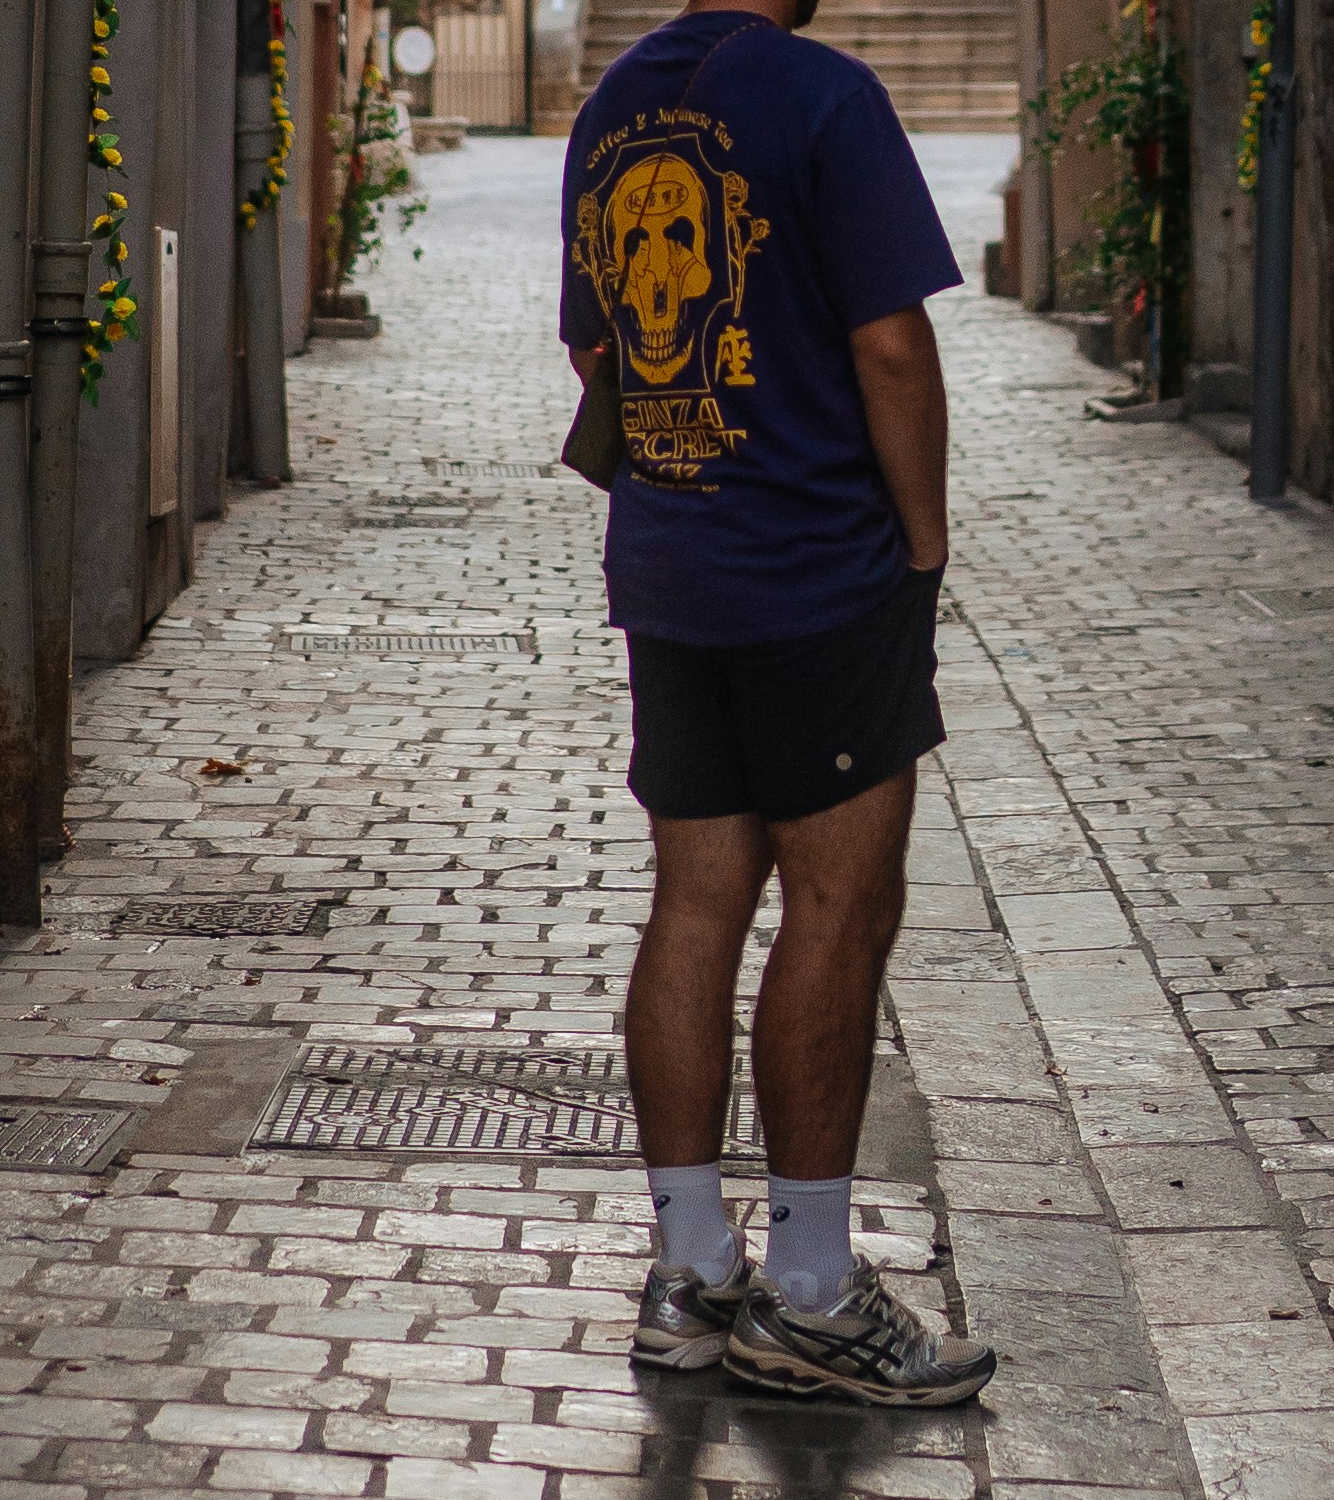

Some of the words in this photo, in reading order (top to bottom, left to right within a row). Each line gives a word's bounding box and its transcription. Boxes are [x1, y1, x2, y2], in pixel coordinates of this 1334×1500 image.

[586, 125, 629, 170] Coffee
[654, 107, 712, 132] Japanese
[714, 119, 734, 152] Tea
[621, 396, 725, 433] GINZA
[624, 428, 748, 461] ECRET
